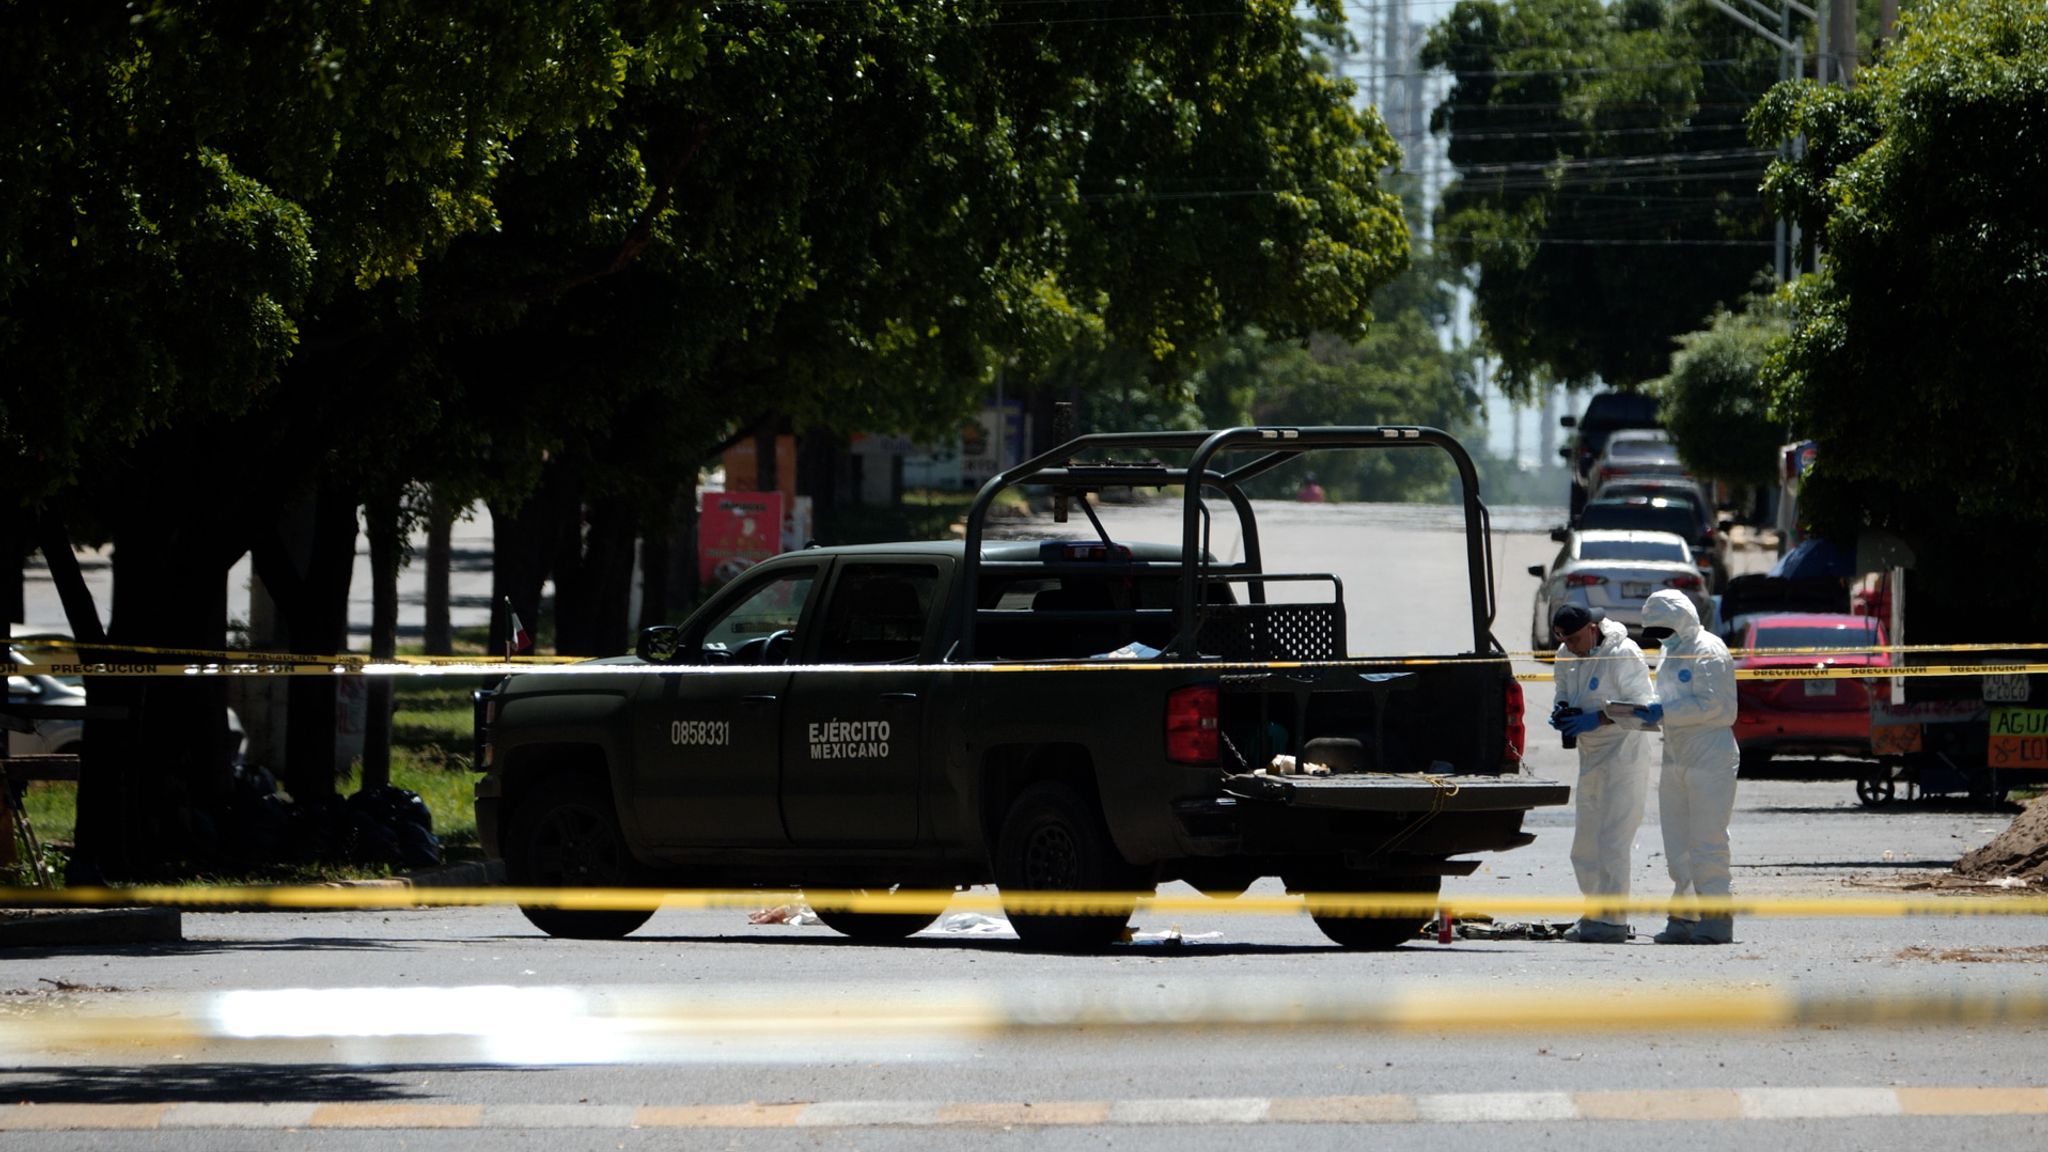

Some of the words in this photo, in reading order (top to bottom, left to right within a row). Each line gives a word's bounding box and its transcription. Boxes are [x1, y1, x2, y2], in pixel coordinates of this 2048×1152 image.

[671, 720, 730, 746] 0858331
[808, 718, 891, 743] EJÉRCITO
[810, 742, 889, 759] MEXICANO
[2020, 737, 2048, 760] CO
